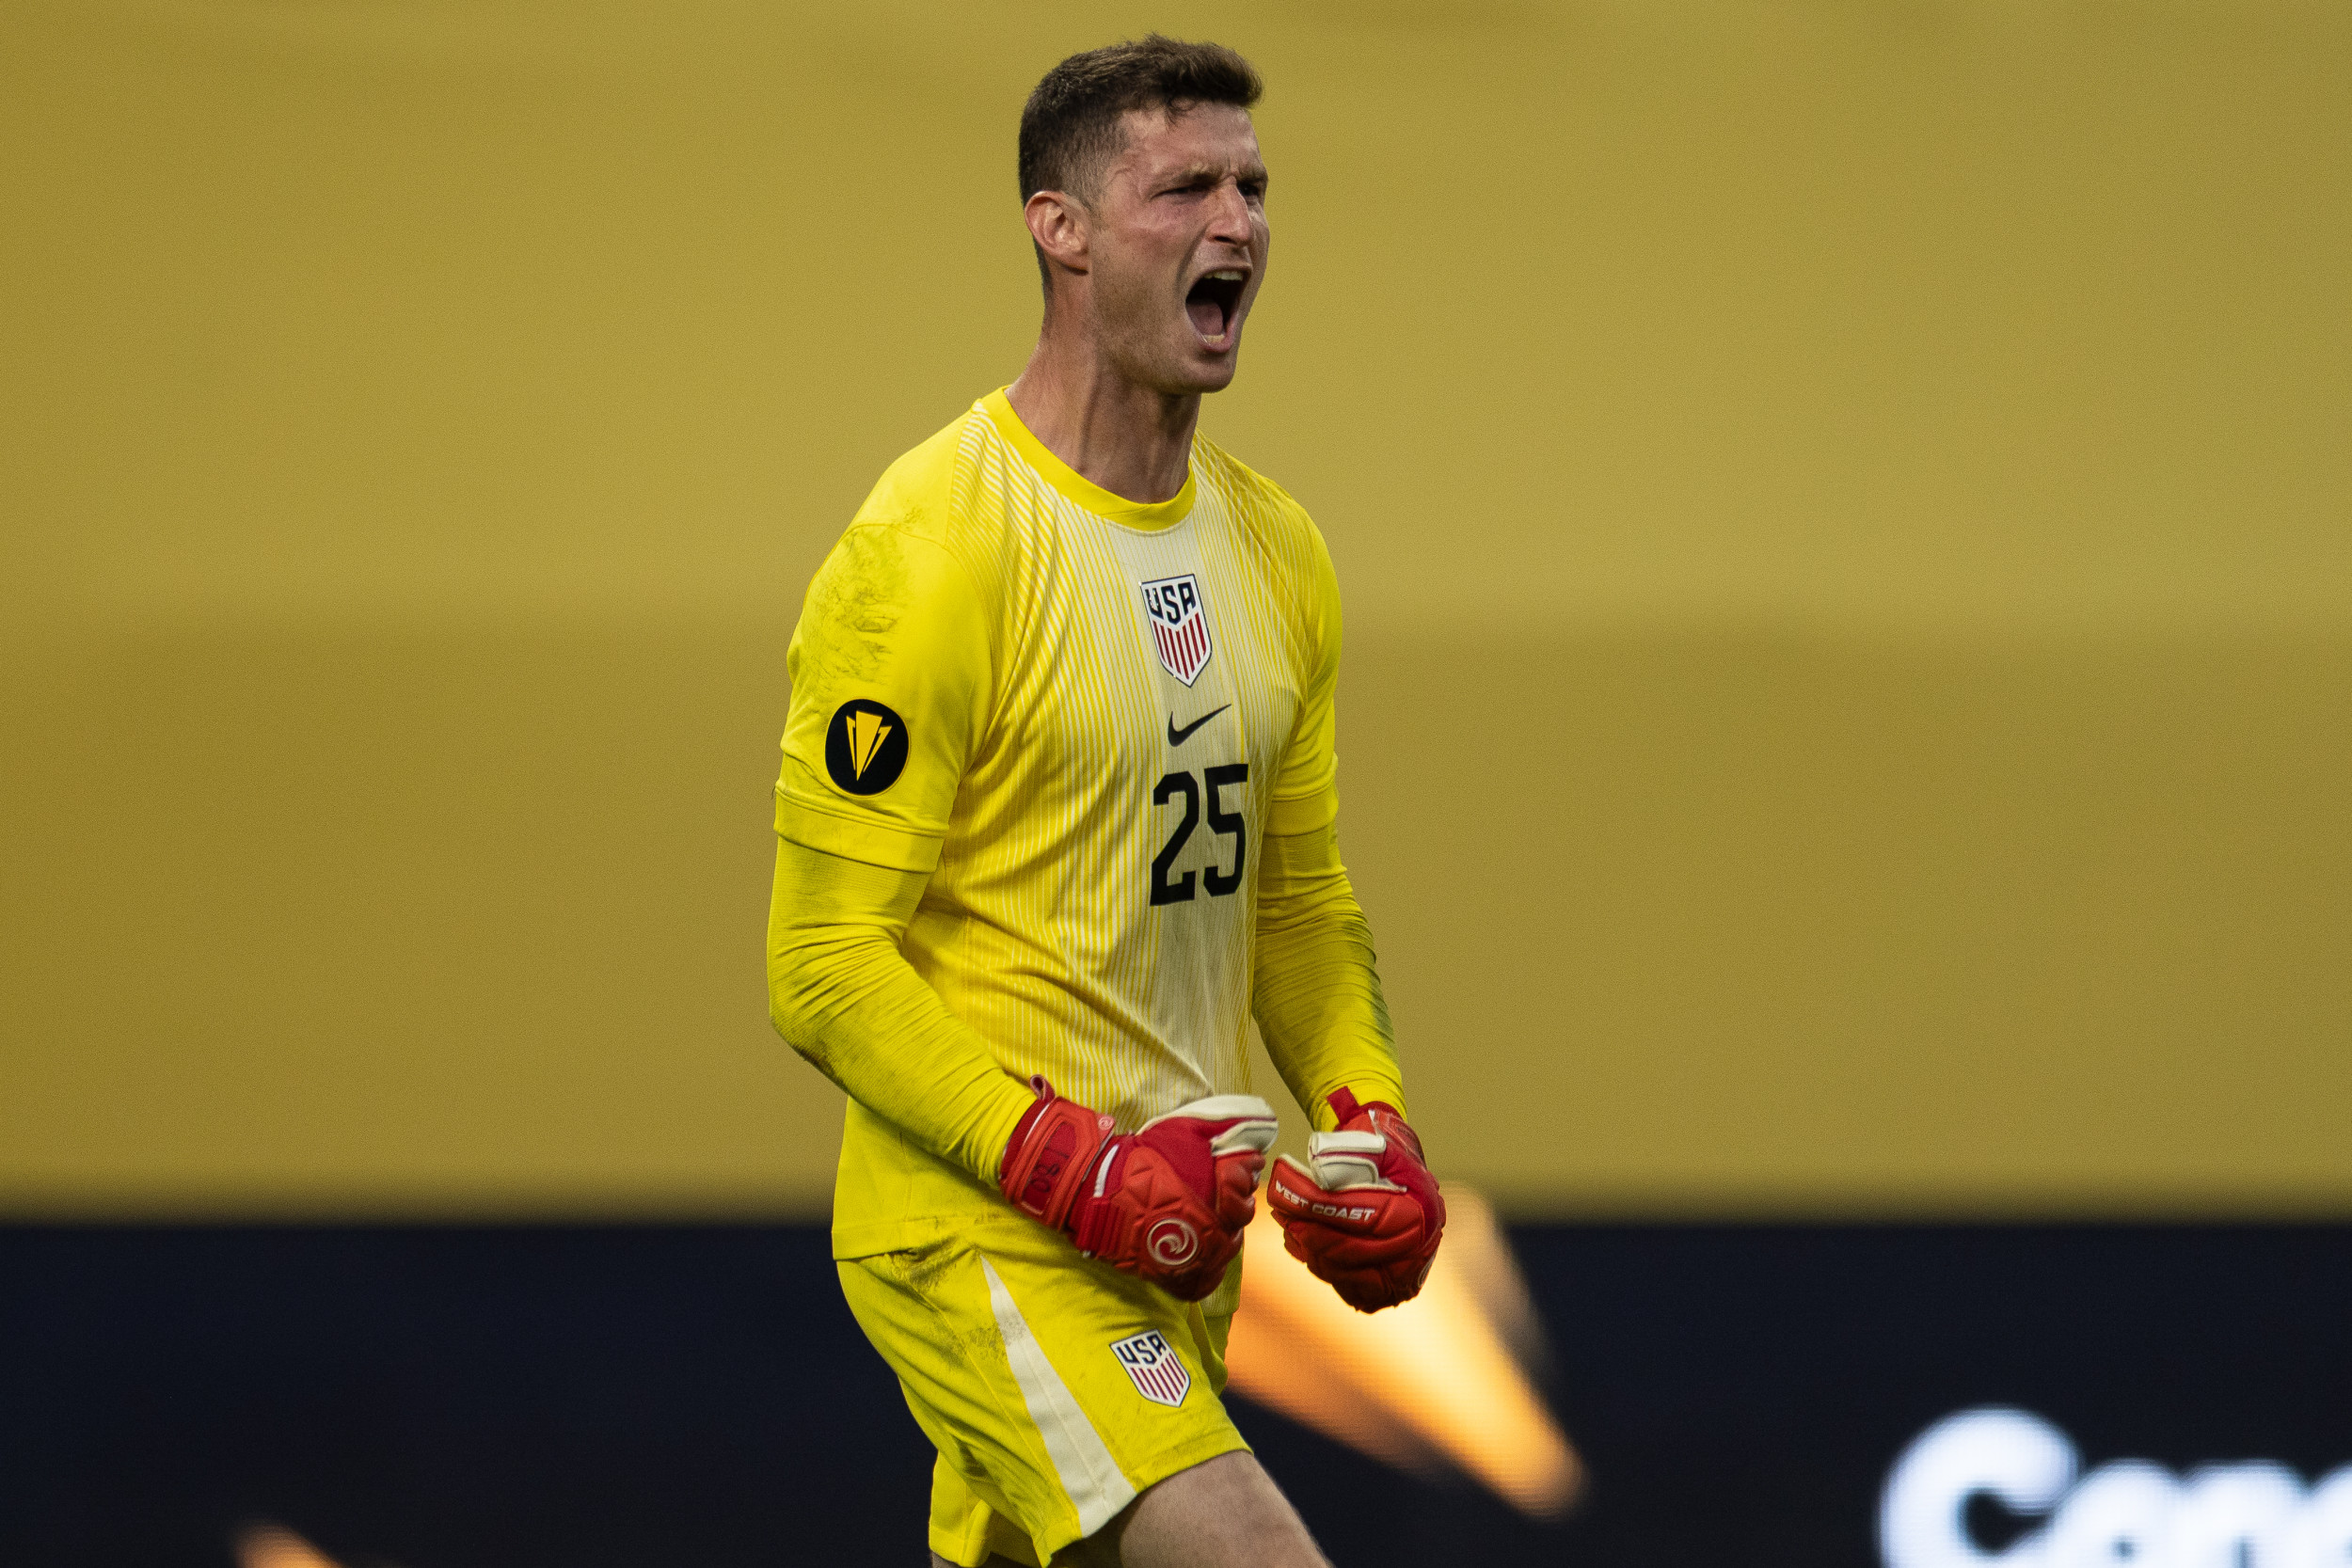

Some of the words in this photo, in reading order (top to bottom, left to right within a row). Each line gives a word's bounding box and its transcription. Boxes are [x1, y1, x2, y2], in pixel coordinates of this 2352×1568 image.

[1144, 581, 1197, 626] USA
[1149, 763, 1249, 907] 25
[1275, 1179, 1310, 1208] WEST
[1311, 1203, 1375, 1223] COAST
[1116, 1334, 1167, 1365] USA
[1877, 1404, 2352, 1568] Con
